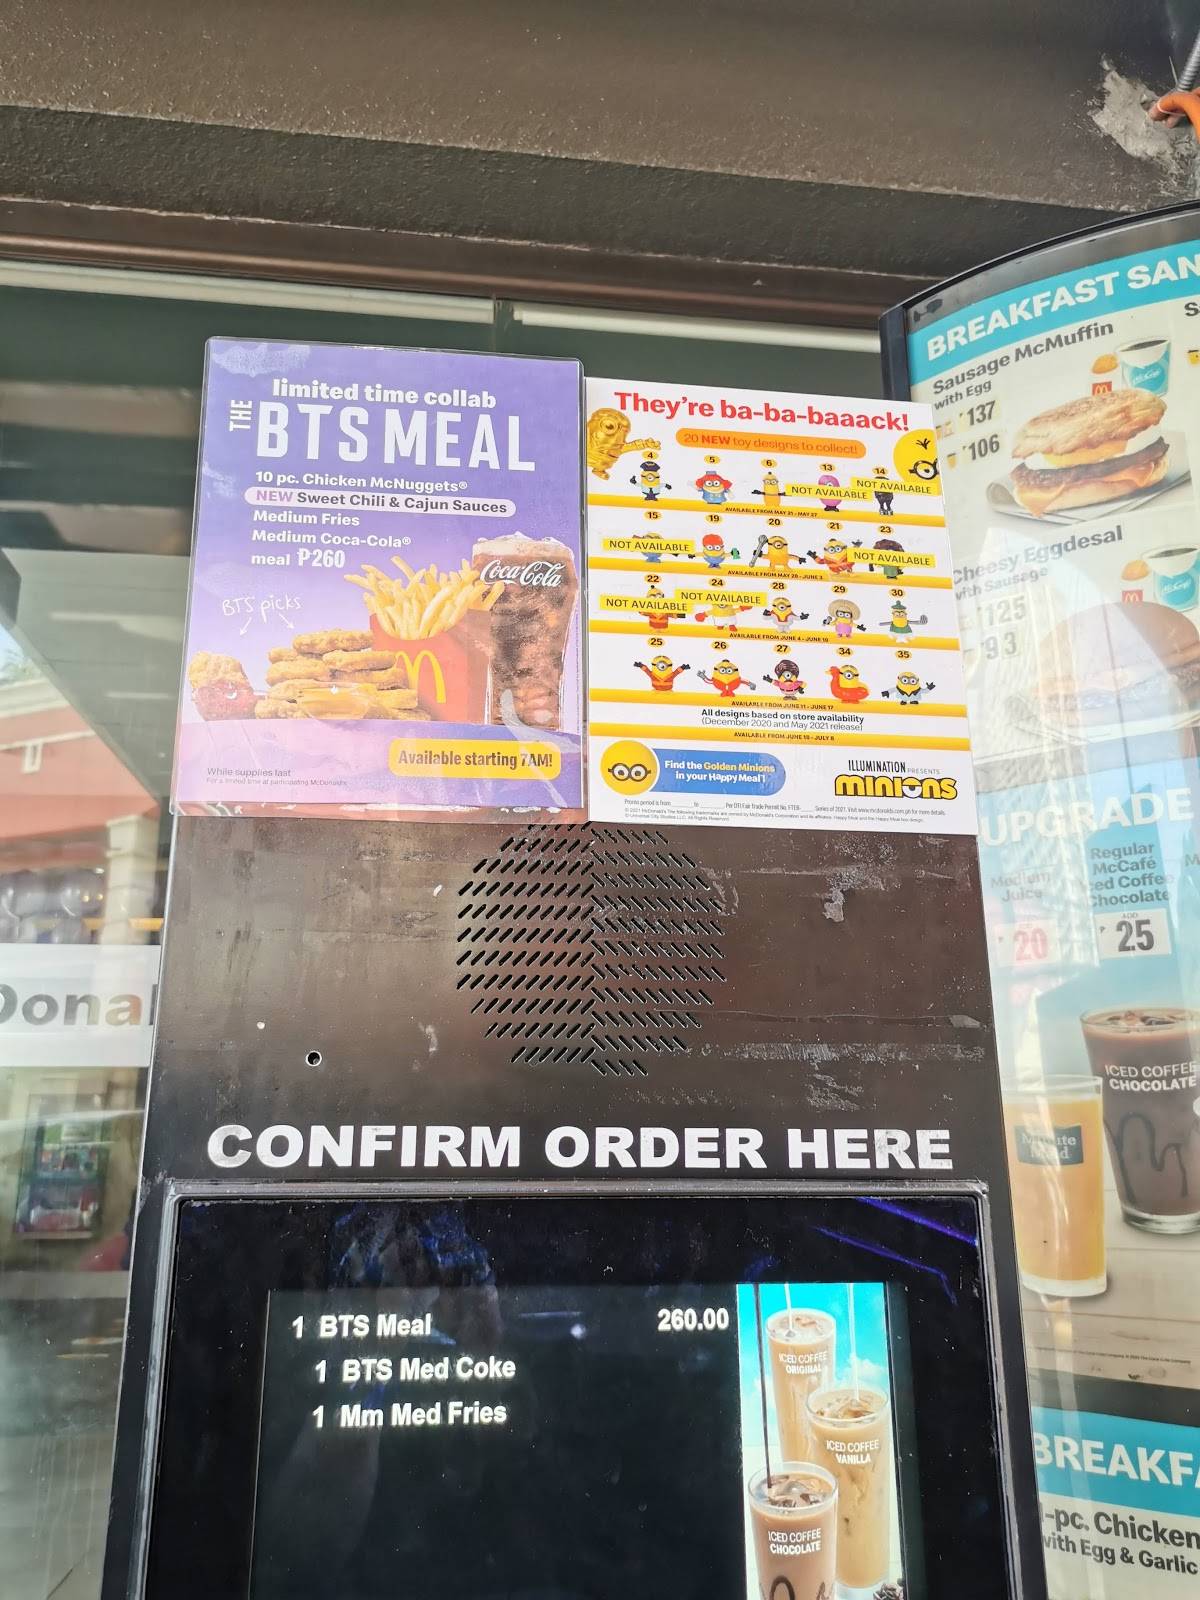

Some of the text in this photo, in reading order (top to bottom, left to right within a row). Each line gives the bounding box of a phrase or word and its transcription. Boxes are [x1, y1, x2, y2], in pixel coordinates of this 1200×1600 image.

[927, 271, 1120, 361] BREAKFAST
[933, 321, 1114, 394] Sausage McMuffin
[272, 377, 497, 408] limited time collab
[934, 380, 992, 410] with Egg
[614, 392, 909, 431] They're ba-ba-baaack!
[967, 400, 996, 426] 137
[229, 399, 535, 471] THE BTS MEAL
[684, 433, 858, 454] 20 NEW toy designs to collect!
[968, 434, 1000, 460] 106
[255, 471, 273, 482] 10
[276, 475, 299, 486] pc.
[302, 473, 366, 487] Chicken
[856, 479, 931, 494] NOT AVAILABLE
[256, 489, 507, 513] NEW Sweet Chili & Cajun Sauces
[791, 486, 868, 500] NOT AVAILABLE
[253, 510, 360, 526] Medium Fries
[647, 511, 658, 519] 15
[709, 514, 719, 522] 19
[768, 518, 781, 526] 20
[830, 522, 840, 530] 21
[252, 530, 411, 548] Medium Coca-Cola®
[609, 540, 689, 551] NOT AVAILABLE
[1024, 525, 1123, 563] Eggdesal
[251, 554, 291, 565] meal
[854, 551, 930, 565] NOT AVAILABLE
[647, 575, 660, 583] 22
[711, 578, 724, 586] 24
[772, 582, 785, 590] 28
[984, 567, 1048, 592] Sausage
[834, 585, 846, 593] 29
[891, 589, 903, 597] 30
[606, 598, 688, 611] NOT AVAILABLE
[681, 591, 761, 604] NOT AVAILABLE
[222, 592, 301, 624] BTS picks
[650, 638, 663, 646] 25
[714, 641, 727, 649] 26
[776, 645, 788, 653] 27
[701, 717, 749, 726] (December
[751, 719, 772, 727] 2020
[773, 720, 789, 728] and
[791, 721, 808, 730] May
[809, 721, 829, 730] 2021
[714, 709, 750, 719] designs
[751, 710, 778, 719] based
[793, 713, 816, 721] store
[817, 714, 865, 725] availability
[398, 750, 552, 770] Available starting 7AM!
[664, 760, 776, 772] Find the Golden Minions
[848, 760, 906, 773] ILLUMINATION
[207, 767, 291, 778] While supplies last
[675, 771, 738, 783] in your Happy
[979, 787, 1195, 846] UPGRADE
[1091, 843, 1154, 860] Regular
[1093, 856, 1156, 875] McCafé
[1118, 873, 1174, 888] Coffee
[1116, 918, 1155, 952] 25
[1013, 927, 1048, 960] 20
[1104, 1060, 1197, 1077] ICED COFFEE
[1109, 1075, 1197, 1091] CHOCOLATE
[206, 1124, 953, 1170] CONFIRM ORDER HERE
[292, 1312, 432, 1339] 1 BTS Meal
[657, 1307, 730, 1332] 260.00
[778, 1351, 828, 1364] ICED COFFEE
[315, 1355, 517, 1384] 1 BTS Med Coke
[785, 1364, 822, 1375] ORIGINAL
[312, 1401, 508, 1428] 1 Mm Med Fries
[826, 1439, 880, 1453] ICED COFFEE
[835, 1453, 872, 1465] VANILLA
[1033, 1431, 1200, 1490] BREAKF
[768, 1528, 822, 1542] ICED COFFEE
[1042, 1507, 1200, 1550] -pc. Chicken
[769, 1540, 821, 1555] CHOCOLATE
[1080, 1538, 1199, 1575] Egg & Garlic
